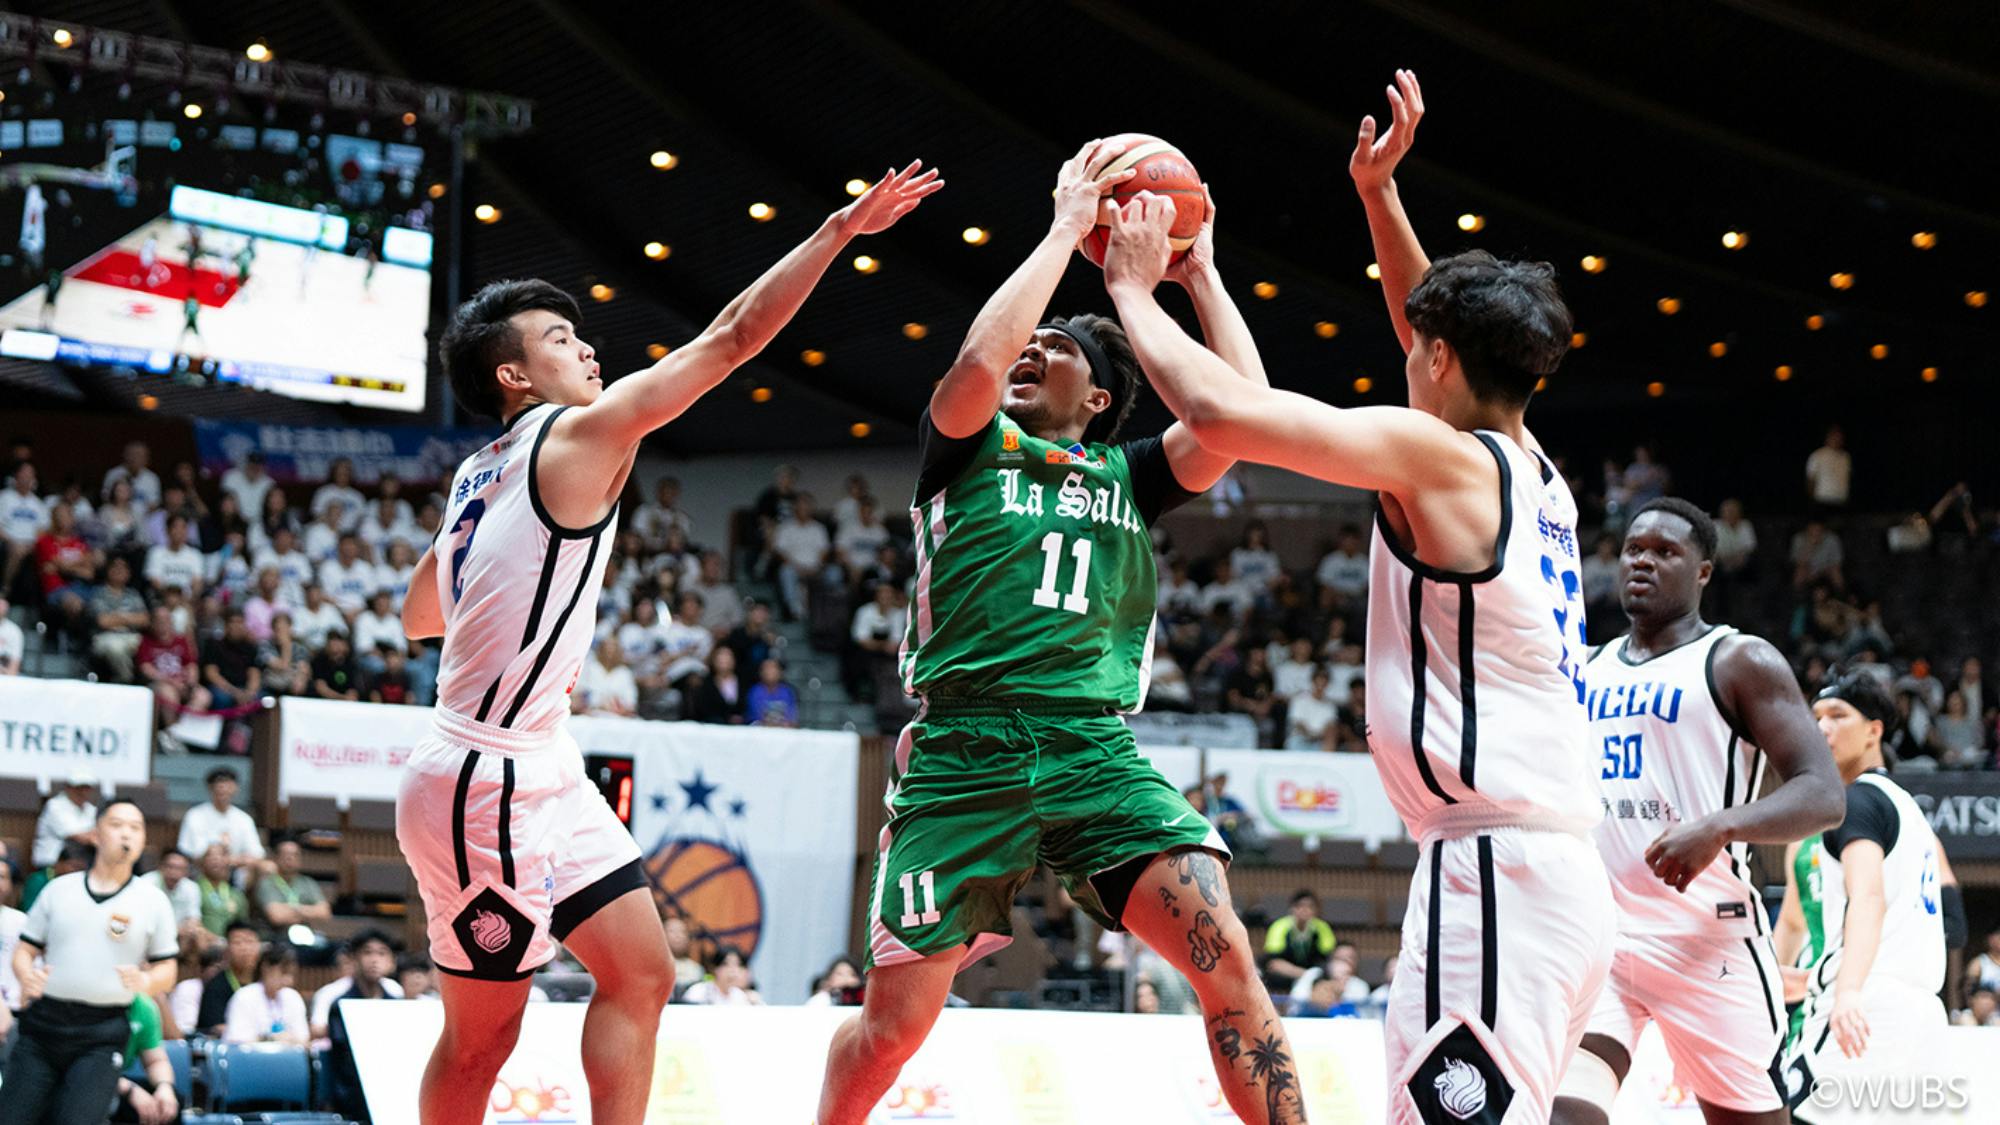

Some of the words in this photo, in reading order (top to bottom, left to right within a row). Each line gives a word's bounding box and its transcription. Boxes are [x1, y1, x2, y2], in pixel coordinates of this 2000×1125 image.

[997, 468, 1045, 517] La
[449, 498, 486, 604] 2
[1032, 531, 1092, 615] 11
[3, 721, 120, 756] TREND
[1601, 733, 1643, 780] 50
[1277, 780, 1340, 806] Dole
[1914, 793, 2000, 837] GATS
[899, 870, 941, 928] 11
